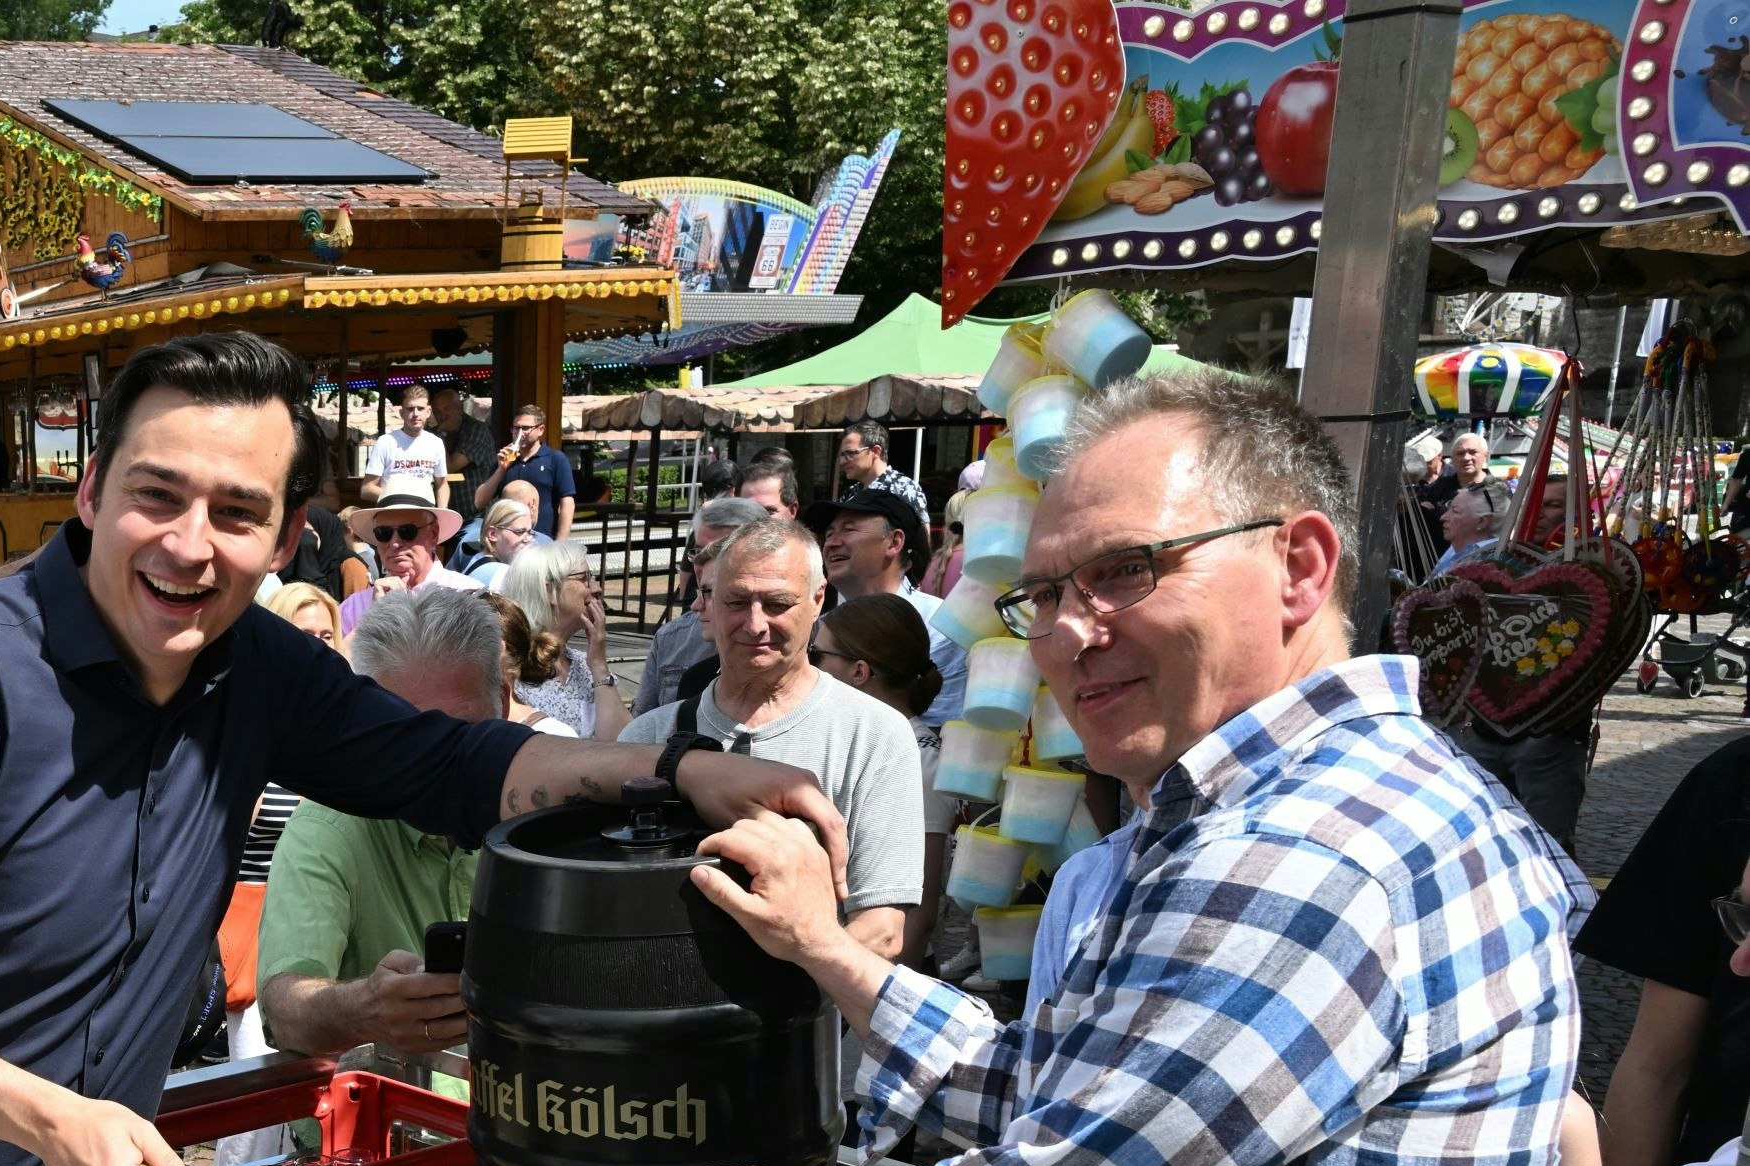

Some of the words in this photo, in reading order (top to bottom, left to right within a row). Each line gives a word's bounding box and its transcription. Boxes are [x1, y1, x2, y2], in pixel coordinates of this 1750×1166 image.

[761, 259, 775, 272] 66
[1500, 600, 1559, 637] Dich
[1491, 632, 1539, 668] lieb
[536, 1079, 707, 1146] Kölsch
